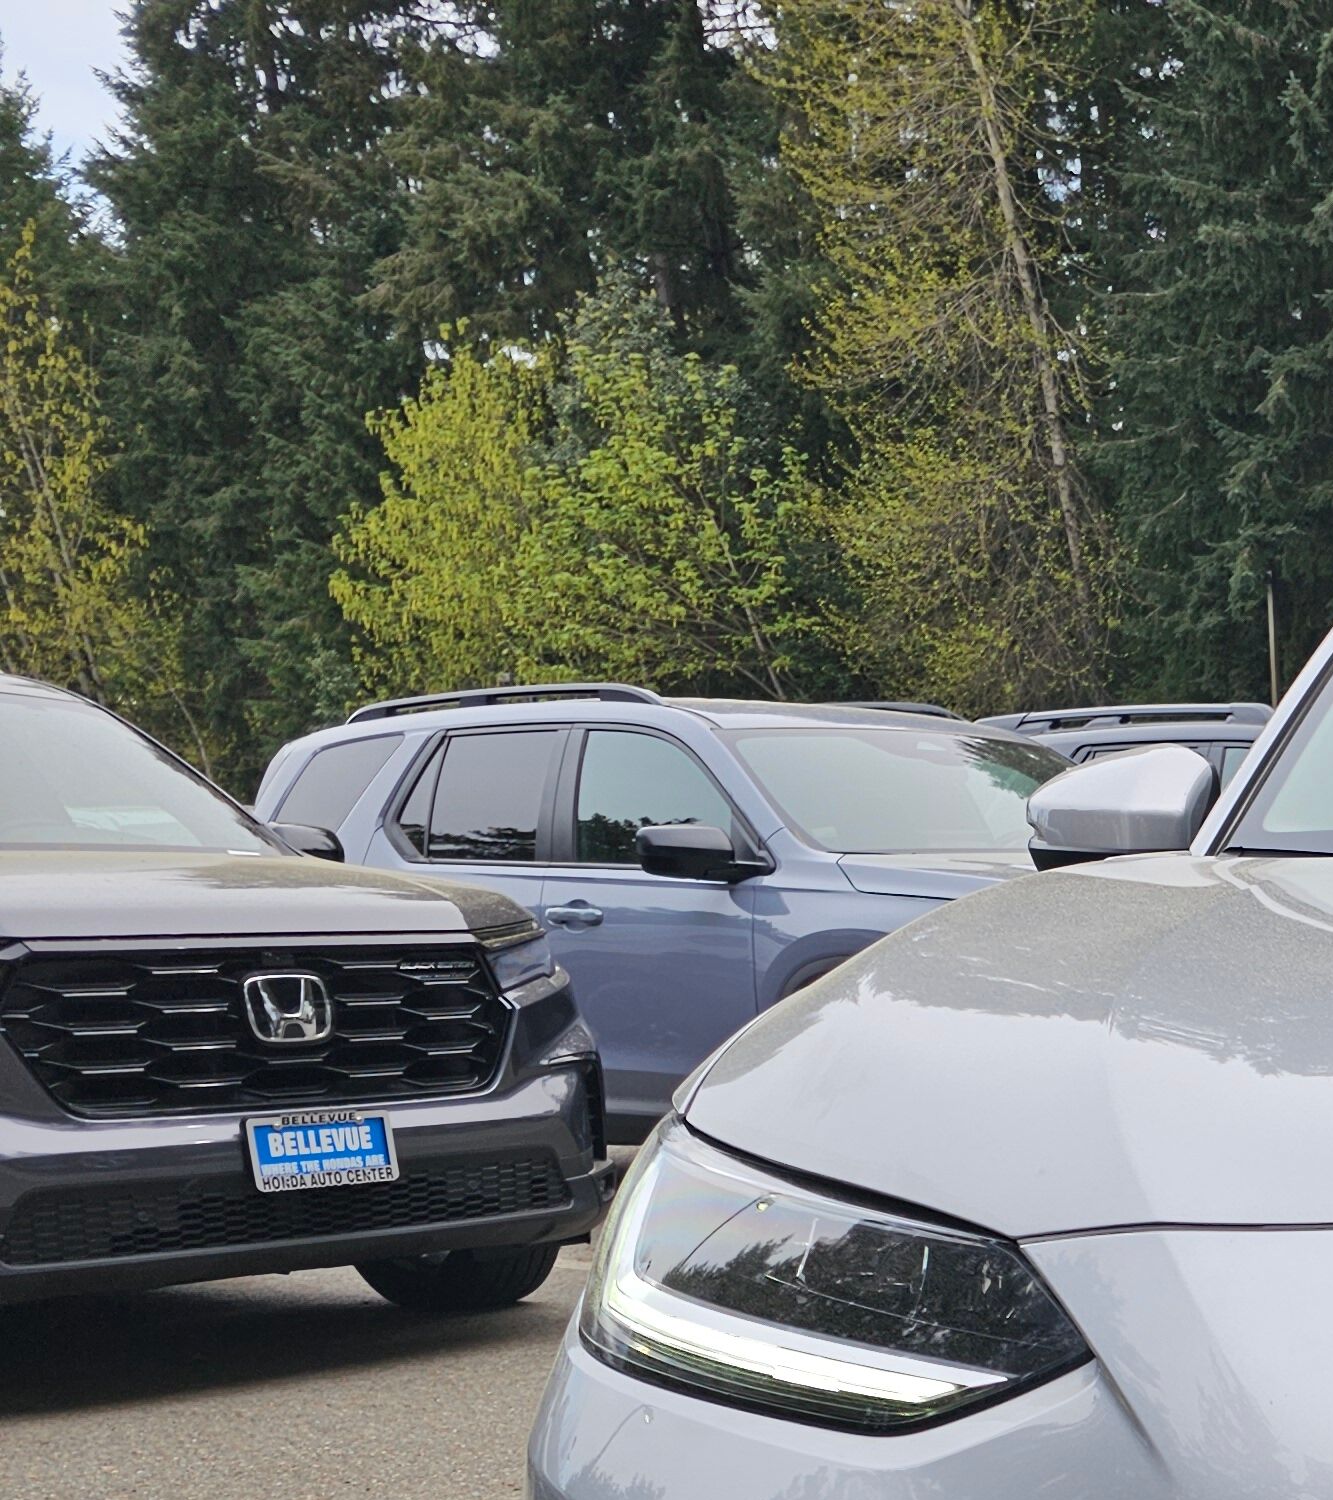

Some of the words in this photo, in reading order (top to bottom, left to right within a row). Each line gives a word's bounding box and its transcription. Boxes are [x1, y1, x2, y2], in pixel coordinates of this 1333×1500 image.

[281, 1112, 357, 1126] BELLEVUE
[267, 1125, 373, 1158] BELLEVUE
[262, 1175, 308, 1191] HONDA
[310, 1171, 343, 1187] AUTO
[346, 1167, 394, 1183] CENTER
